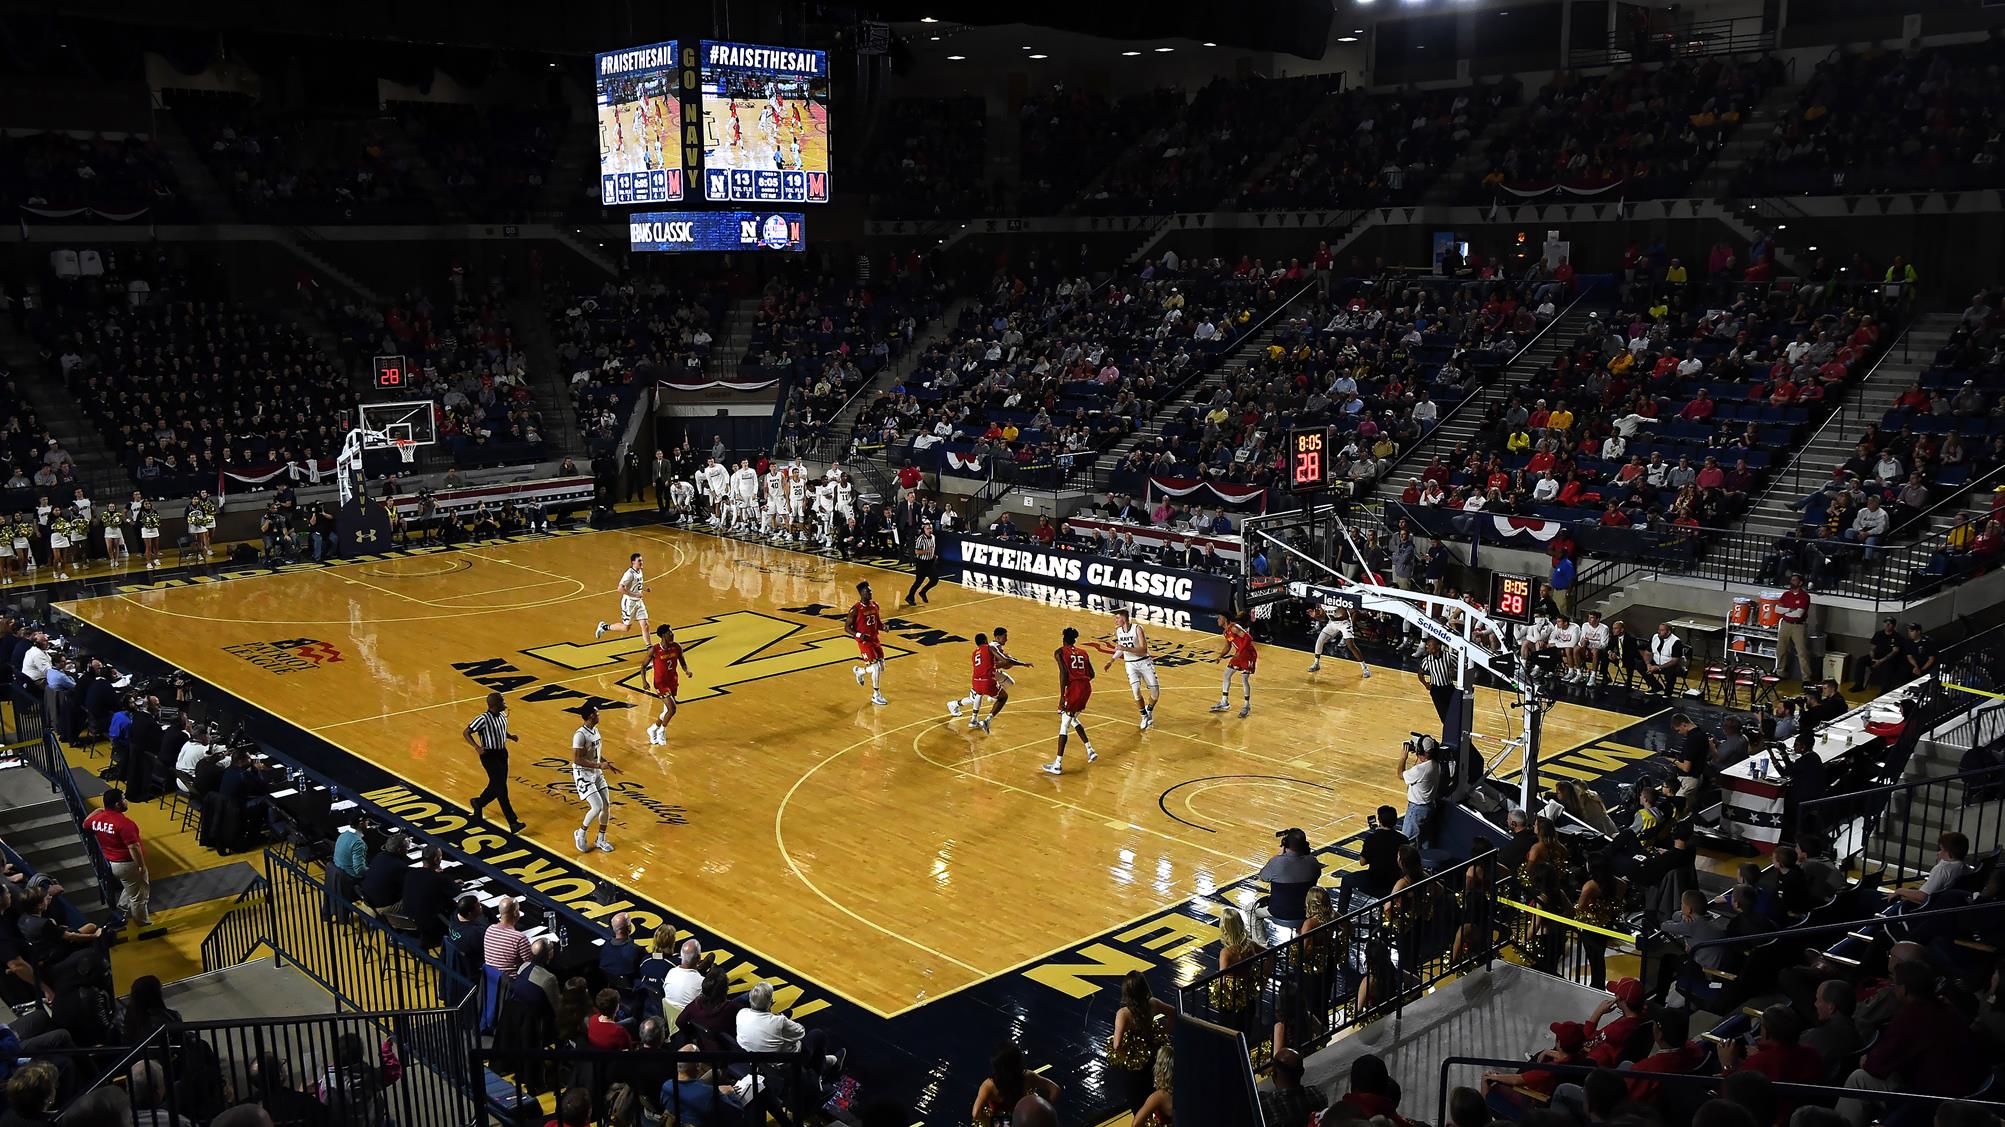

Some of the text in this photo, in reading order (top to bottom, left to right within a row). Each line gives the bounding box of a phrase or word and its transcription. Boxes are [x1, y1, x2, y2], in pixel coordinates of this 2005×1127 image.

[601, 46, 673, 75] #RAISETHESAIL
[710, 45, 818, 73] #RAISETHESAIL
[683, 48, 698, 188] GO NAVY
[604, 180, 615, 197] N
[619, 176, 630, 189] 13
[652, 173, 664, 186] 19
[668, 170, 681, 195] M
[710, 174, 726, 193] N
[734, 173, 750, 185] 13
[786, 174, 802, 187] 19
[809, 173, 824, 197] M
[653, 222, 694, 243] CLASSIC
[380, 368, 401, 385] 28
[1298, 433, 1322, 452] 8:05
[1295, 452, 1319, 482] 28
[960, 540, 1082, 582] VETERANS
[1086, 563, 1193, 601] CLASSIC
[1503, 579, 1528, 596] 8:05
[1323, 593, 1354, 609] leidos
[1501, 594, 1522, 614] 28
[1762, 603, 1770, 612] G
[866, 614, 876, 626] 23
[1416, 617, 1452, 643] Schelde
[222, 645, 296, 676] LEAGUE
[242, 641, 321, 671] PATRIOT
[666, 659, 673, 671] 2
[974, 653, 982, 666] 5
[1070, 654, 1086, 670] 25
[450, 657, 638, 715] NAVY
